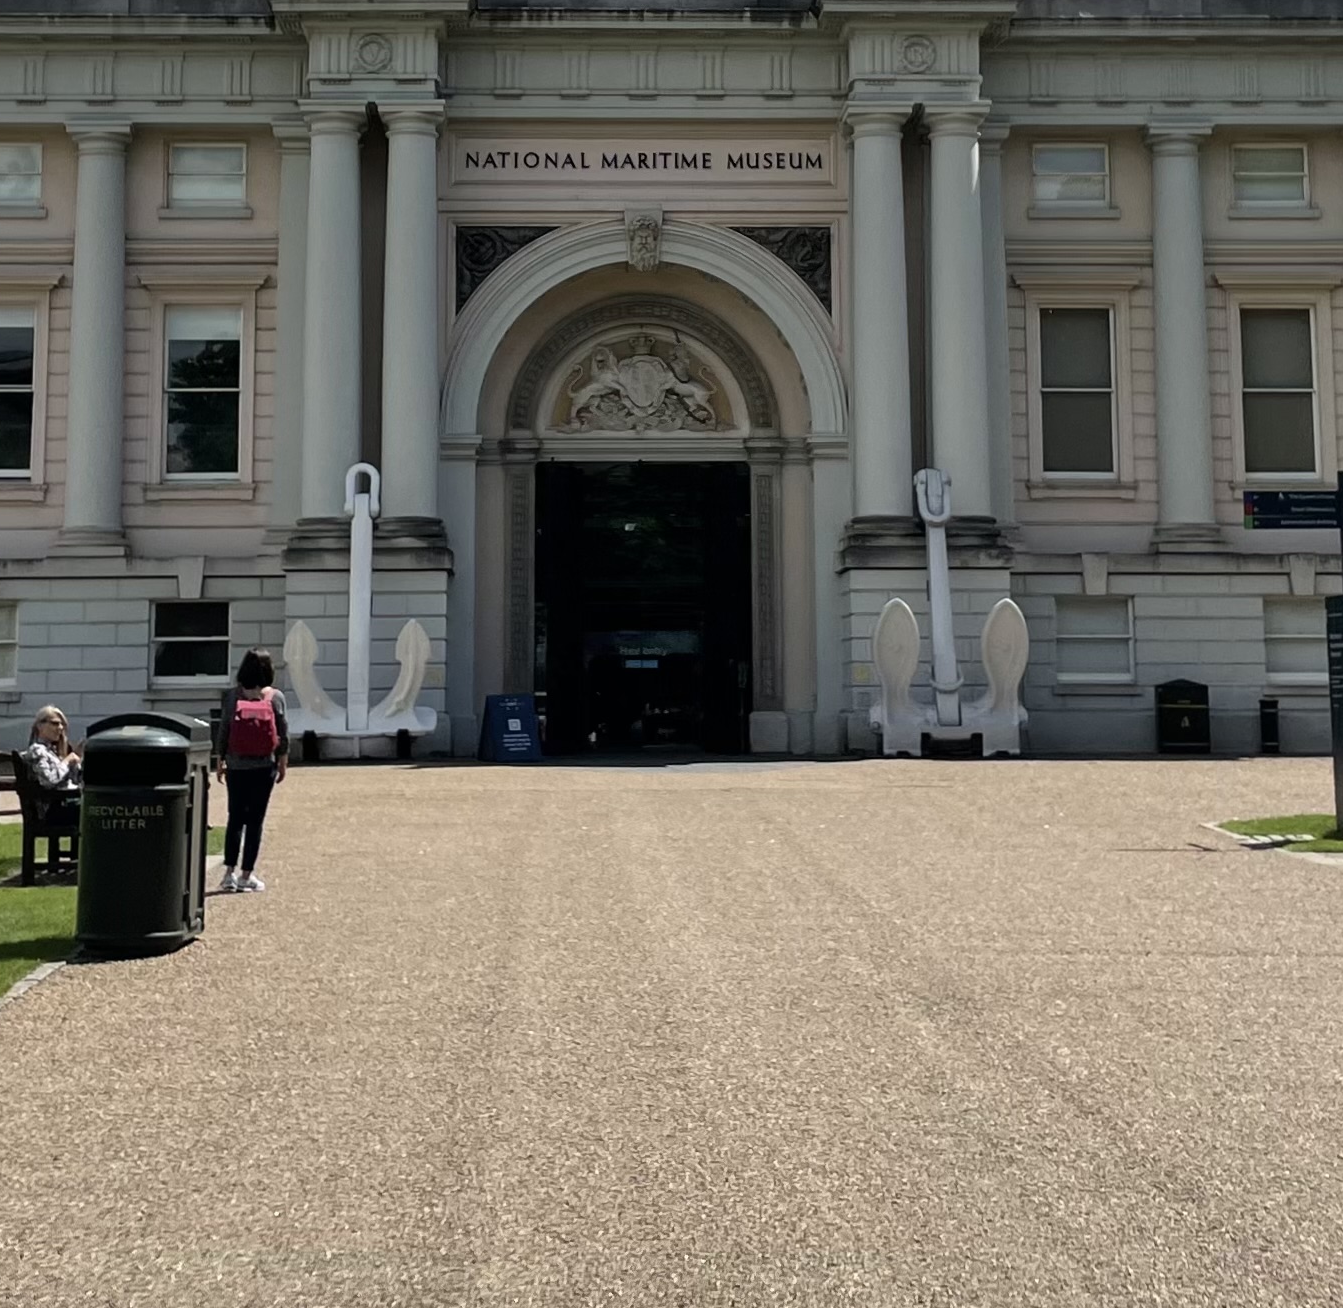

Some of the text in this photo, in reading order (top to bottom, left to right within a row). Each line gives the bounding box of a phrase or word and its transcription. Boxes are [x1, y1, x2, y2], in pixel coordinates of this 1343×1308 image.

[465, 151, 823, 170] NATIONAL MARITIME MUSEUM
[89, 805, 164, 817] RECYCLABLE
[101, 819, 147, 829] LITTER
